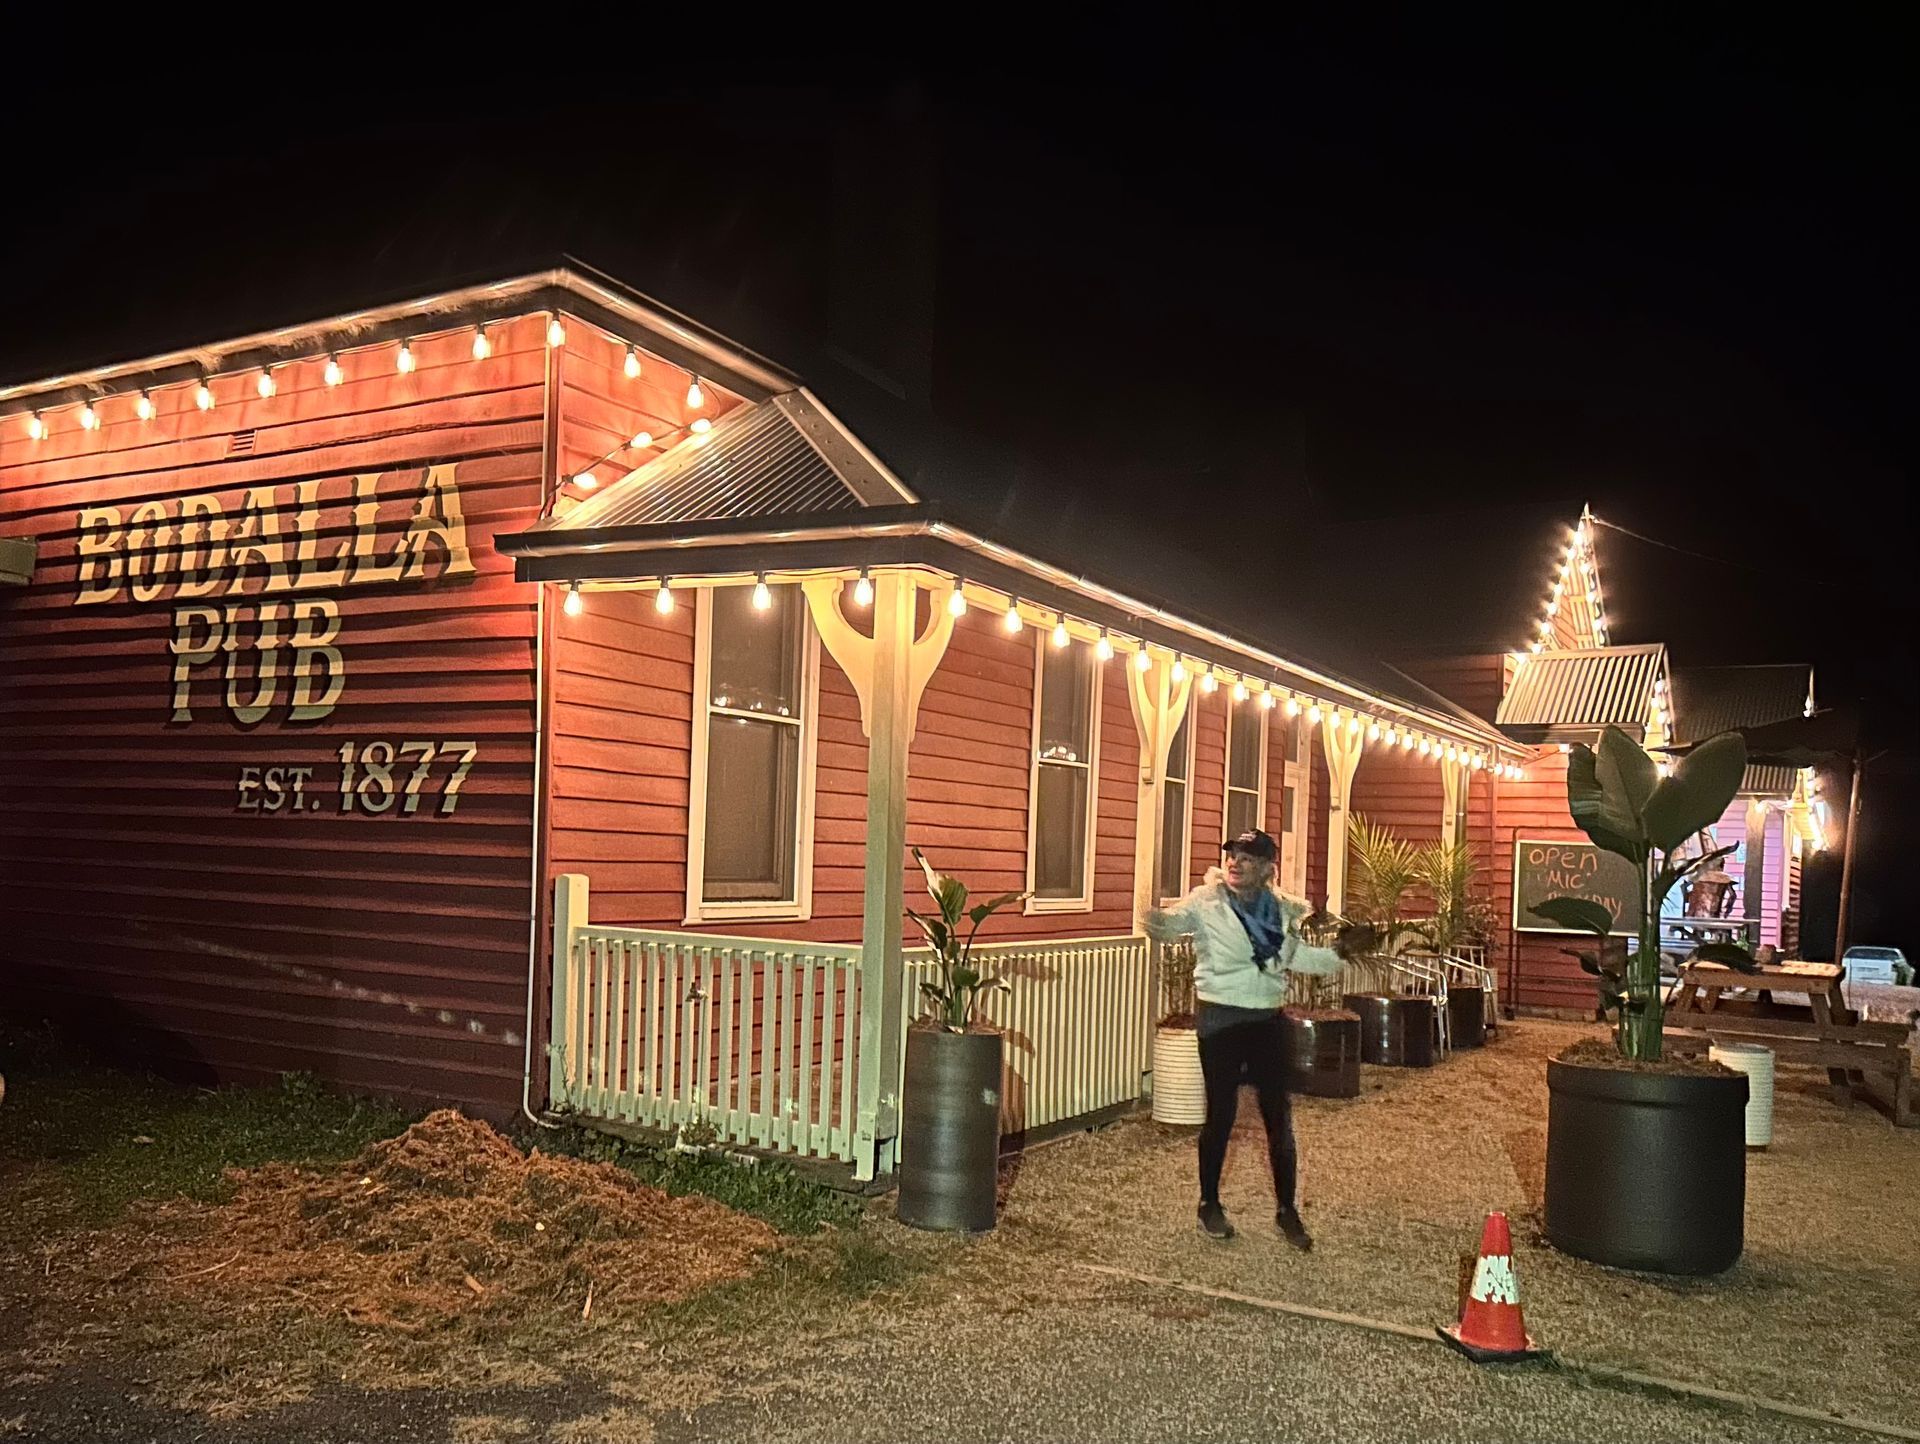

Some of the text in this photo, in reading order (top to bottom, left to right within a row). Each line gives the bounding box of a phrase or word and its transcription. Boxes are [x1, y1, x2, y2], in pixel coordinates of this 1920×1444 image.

[74, 462, 477, 605] BODALLA
[169, 598, 346, 723] PUB
[237, 741, 477, 813] EST. 1877
